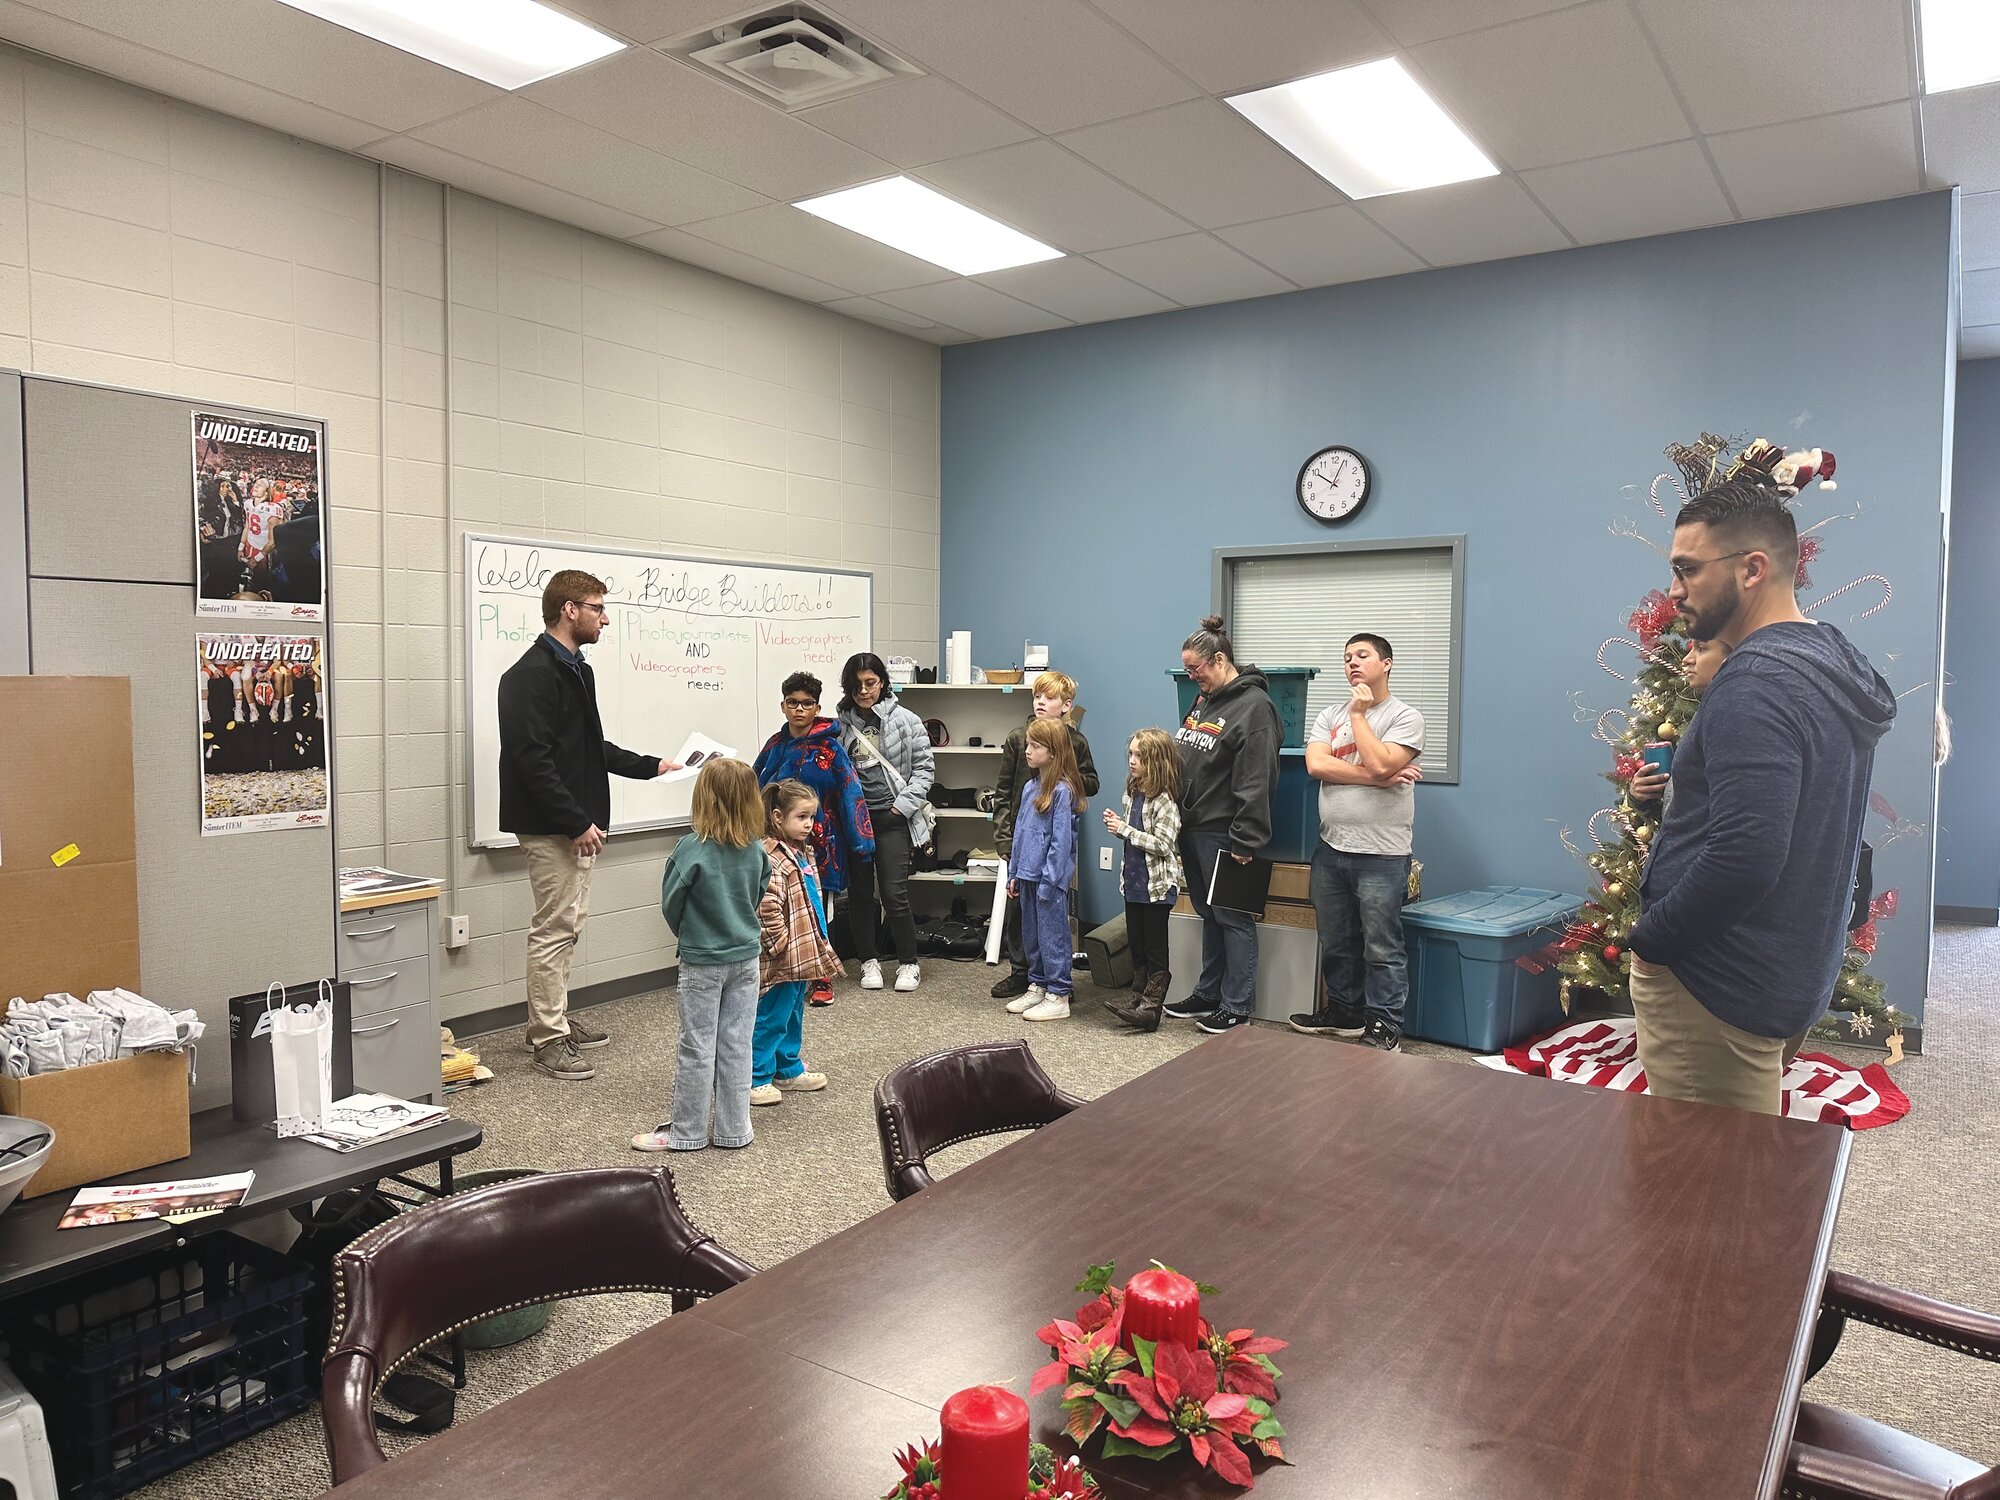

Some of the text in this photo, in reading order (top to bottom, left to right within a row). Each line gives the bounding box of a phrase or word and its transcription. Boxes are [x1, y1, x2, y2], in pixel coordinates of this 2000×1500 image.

[200, 421, 312, 454] UNDEFEATED.
[1331, 456, 1340, 464] 12
[1312, 468, 1320, 476] 10
[1352, 467, 1357, 475] 2
[1307, 481, 1313, 489] 9
[1355, 479, 1361, 487] 3
[1310, 493, 1316, 501] 8
[1350, 491, 1356, 499] 4
[1329, 504, 1335, 512] 6
[477, 546, 632, 600] Welce,
[637, 567, 712, 624] Bridge
[718, 574, 833, 614] Builders!!
[627, 611, 751, 644] Photojournalists
[760, 622, 853, 650] Videographers
[205, 642, 314, 661] UNDEFEATED.
[685, 642, 711, 658] AND
[803, 649, 837, 663] need:
[630, 653, 726, 678] Videographers
[687, 680, 724, 691] need:
[1183, 729, 1217, 750] CANYON
